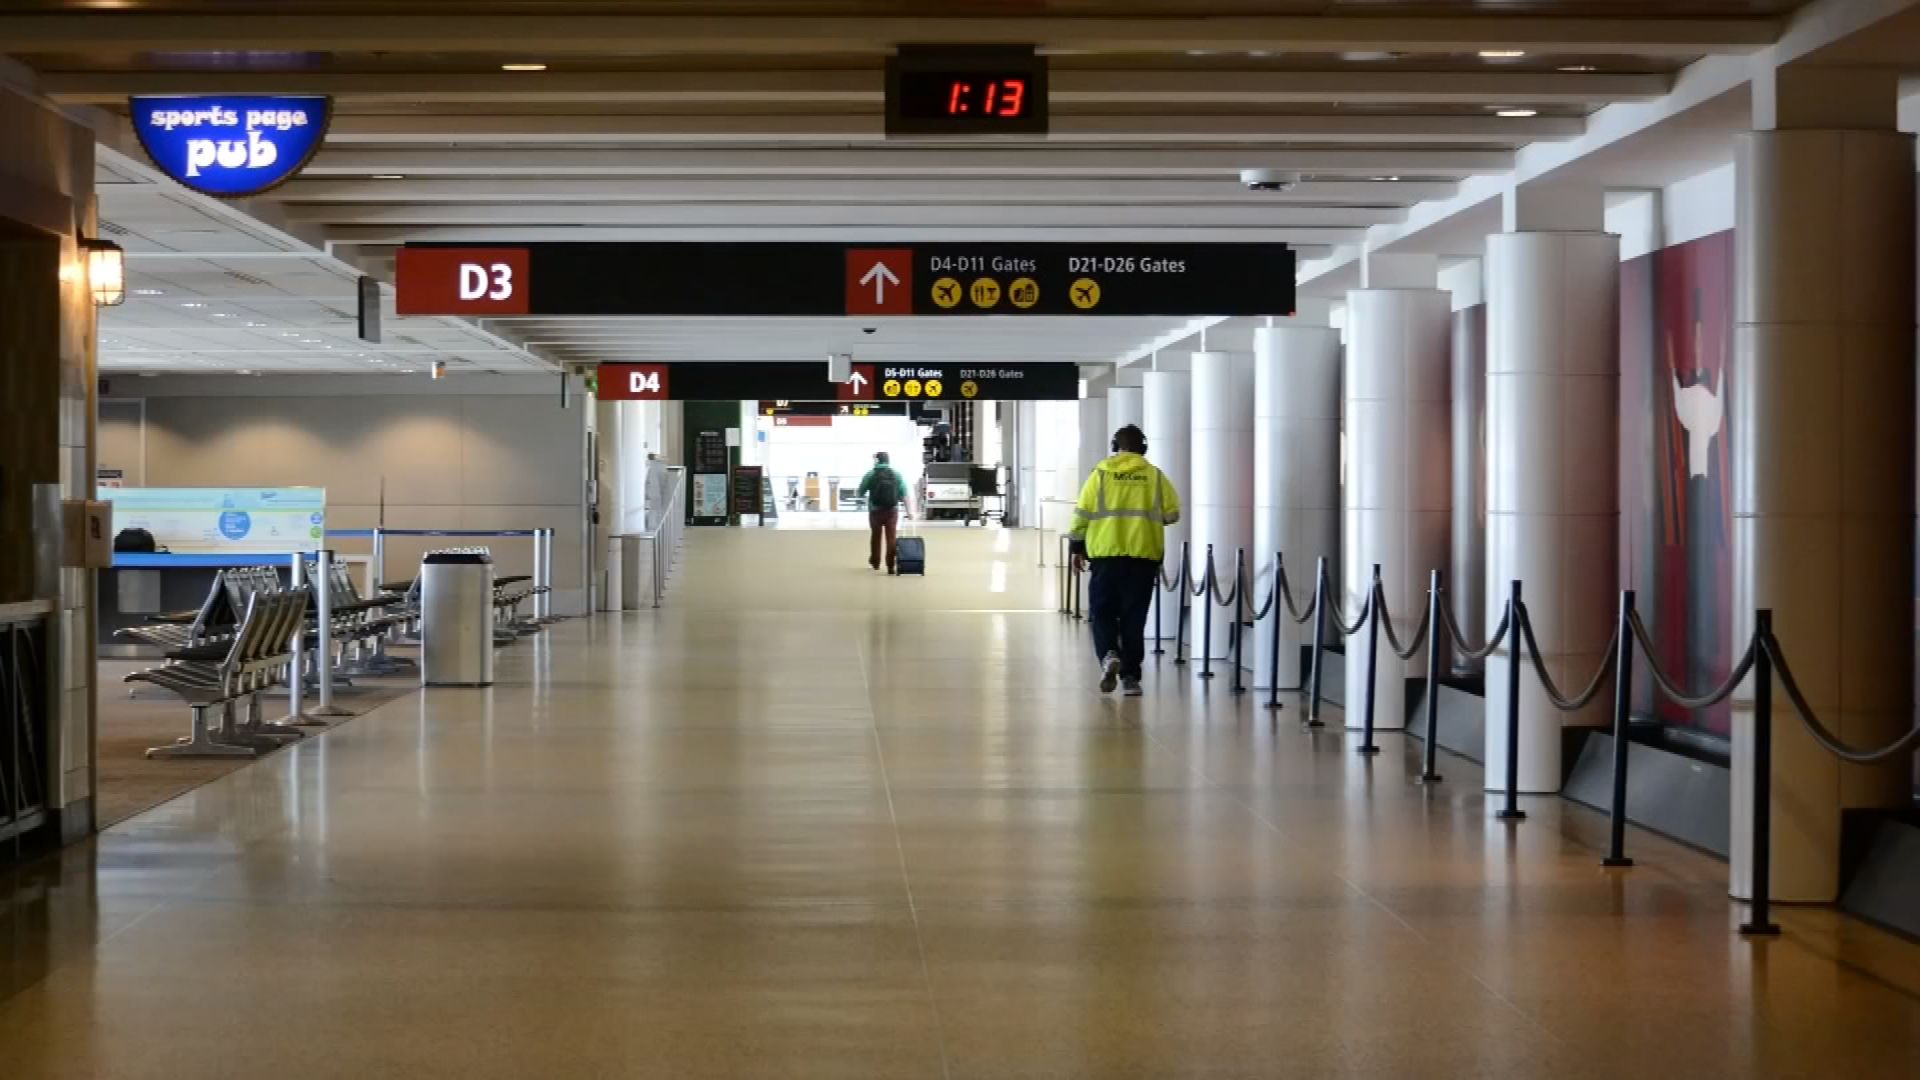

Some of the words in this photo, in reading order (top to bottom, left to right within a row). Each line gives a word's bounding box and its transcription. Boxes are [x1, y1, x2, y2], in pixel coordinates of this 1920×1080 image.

[949, 80, 1024, 116] 1:13
[151, 105, 238, 131] sports
[245, 109, 308, 131] page
[185, 130, 277, 177] pub
[930, 256, 984, 272] D4-D11
[991, 256, 1036, 272] Gates
[1068, 257, 1135, 273] D21-D26
[1140, 257, 1186, 273] Gates
[459, 263, 512, 300] D3
[629, 371, 660, 393] D4
[917, 367, 943, 378] Gates
[998, 369, 1024, 379] Gates
